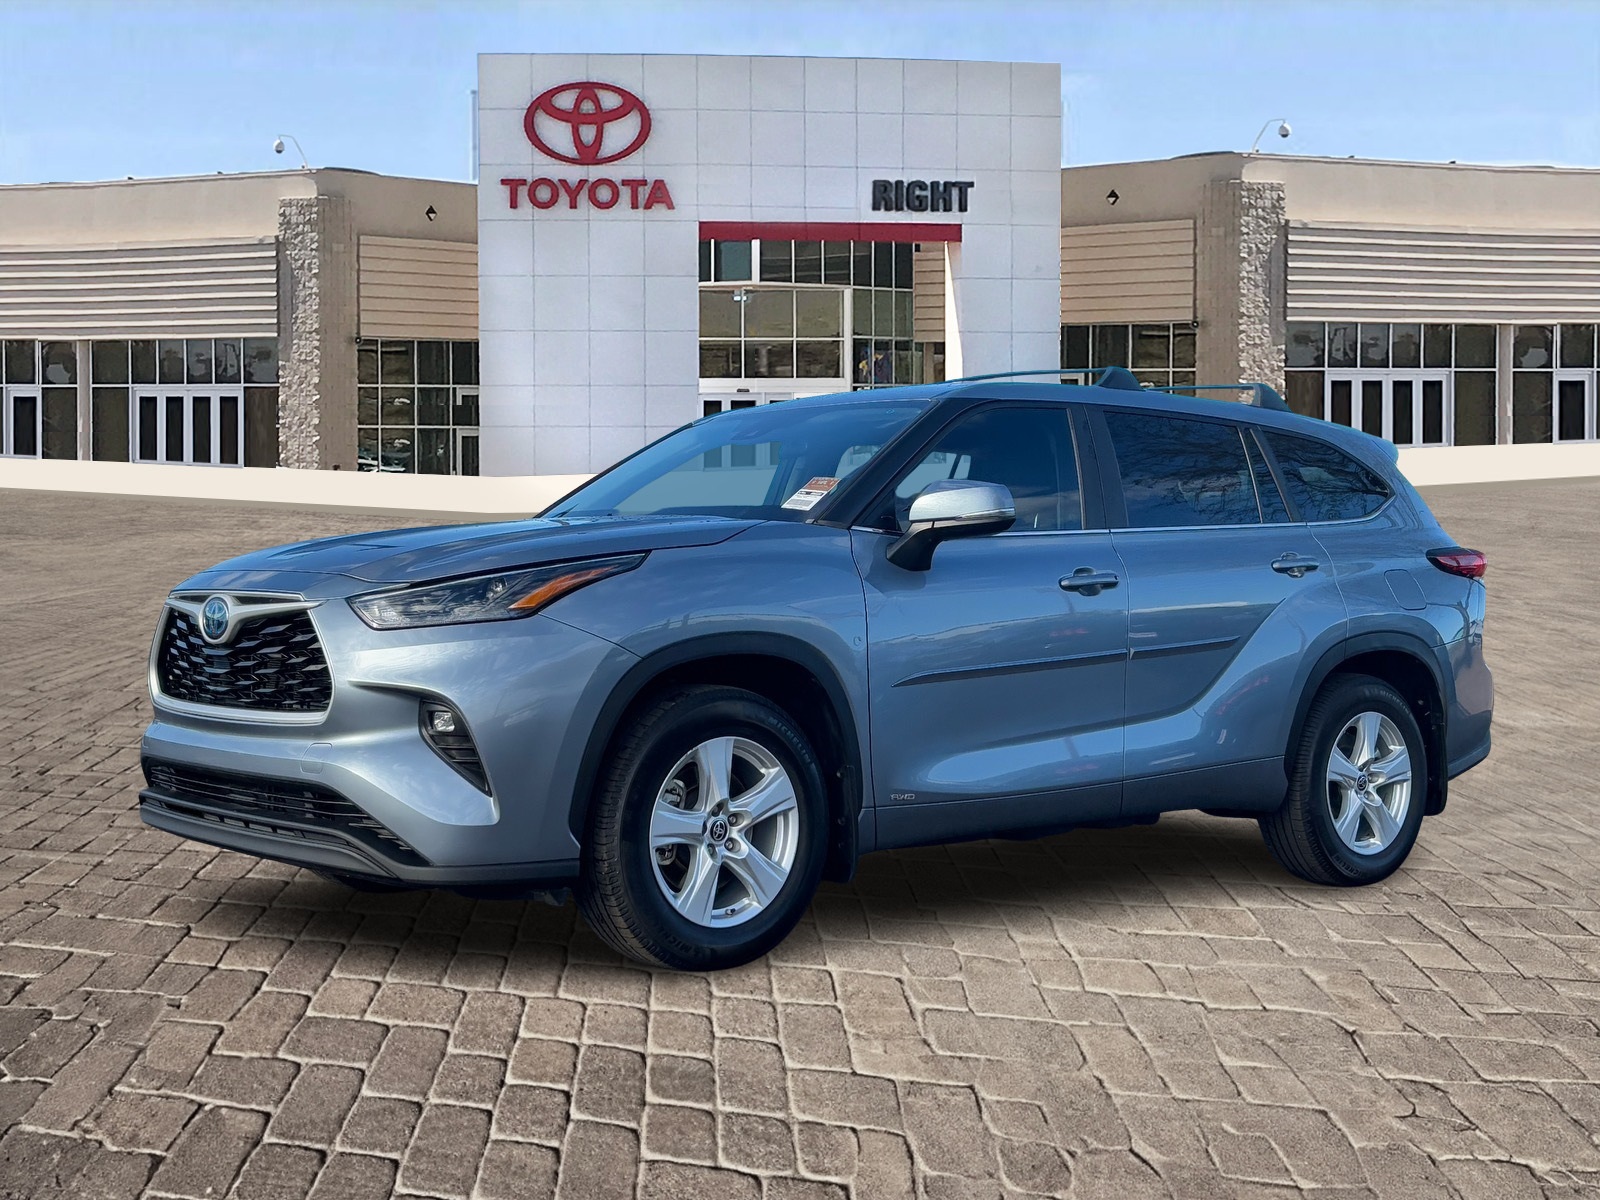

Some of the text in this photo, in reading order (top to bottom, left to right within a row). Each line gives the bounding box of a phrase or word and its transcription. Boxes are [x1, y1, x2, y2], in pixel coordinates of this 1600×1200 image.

[500, 178, 675, 209] TOYOTA
[872, 179, 974, 212] RIGHT
[767, 715, 811, 763] MICHELIN
